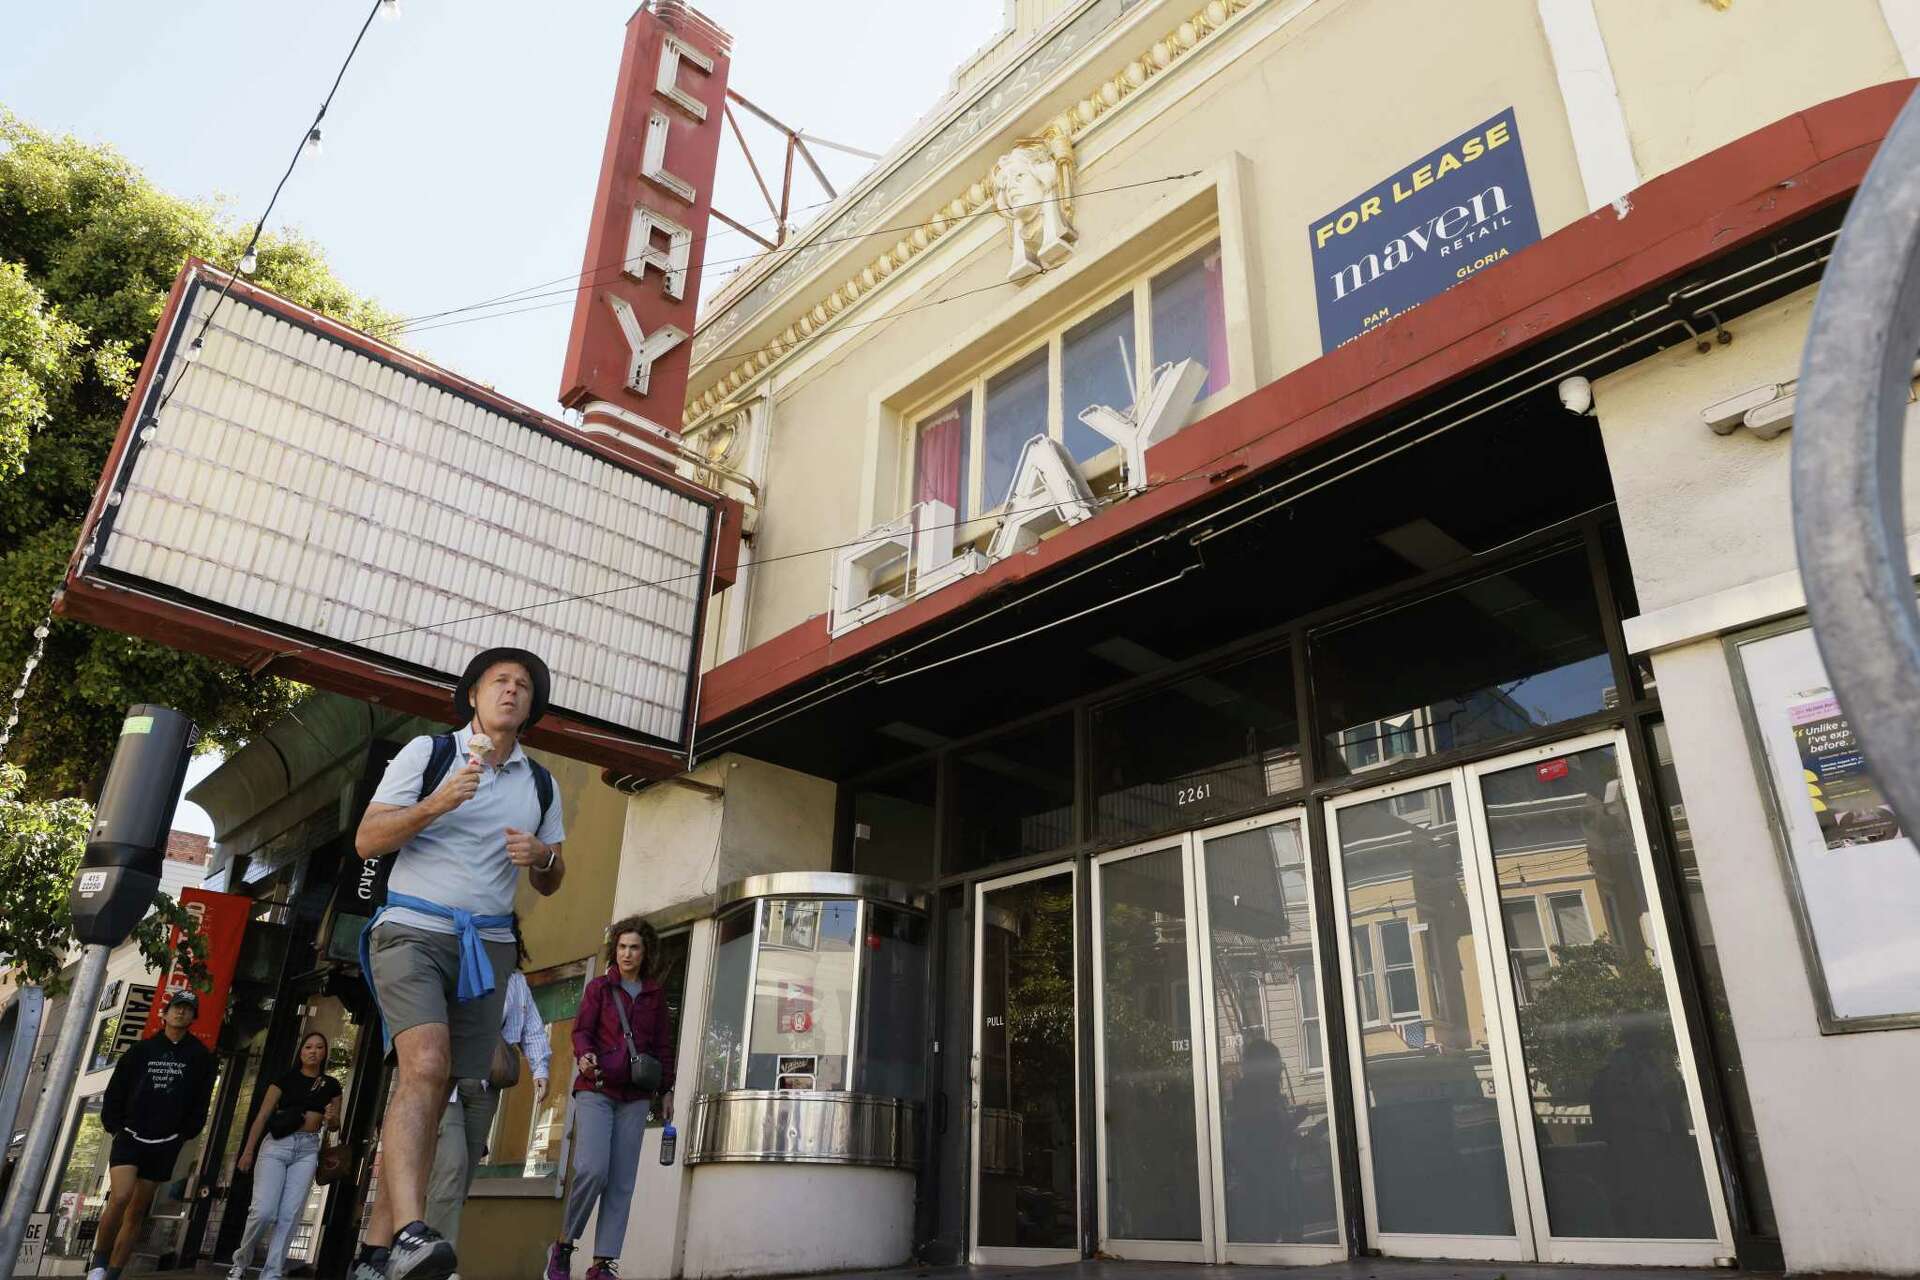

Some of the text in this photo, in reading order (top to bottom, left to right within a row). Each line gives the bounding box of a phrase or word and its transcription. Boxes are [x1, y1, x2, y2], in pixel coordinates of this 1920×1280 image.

[1315, 121, 1511, 249] FOR LEASE
[604, 33, 714, 398] CLAY
[1330, 184, 1513, 302] maven
[1440, 217, 1512, 257] RETAIL
[1456, 247, 1509, 278] GLORIA
[1363, 307, 1390, 327] PAM
[1805, 721, 1839, 736] Unlike
[1808, 730, 1851, 745] I've exp
[1810, 739, 1849, 753] before.
[1178, 783, 1210, 806] 2261
[357, 855, 380, 900] EARD
[986, 1016, 1005, 1028] PULL
